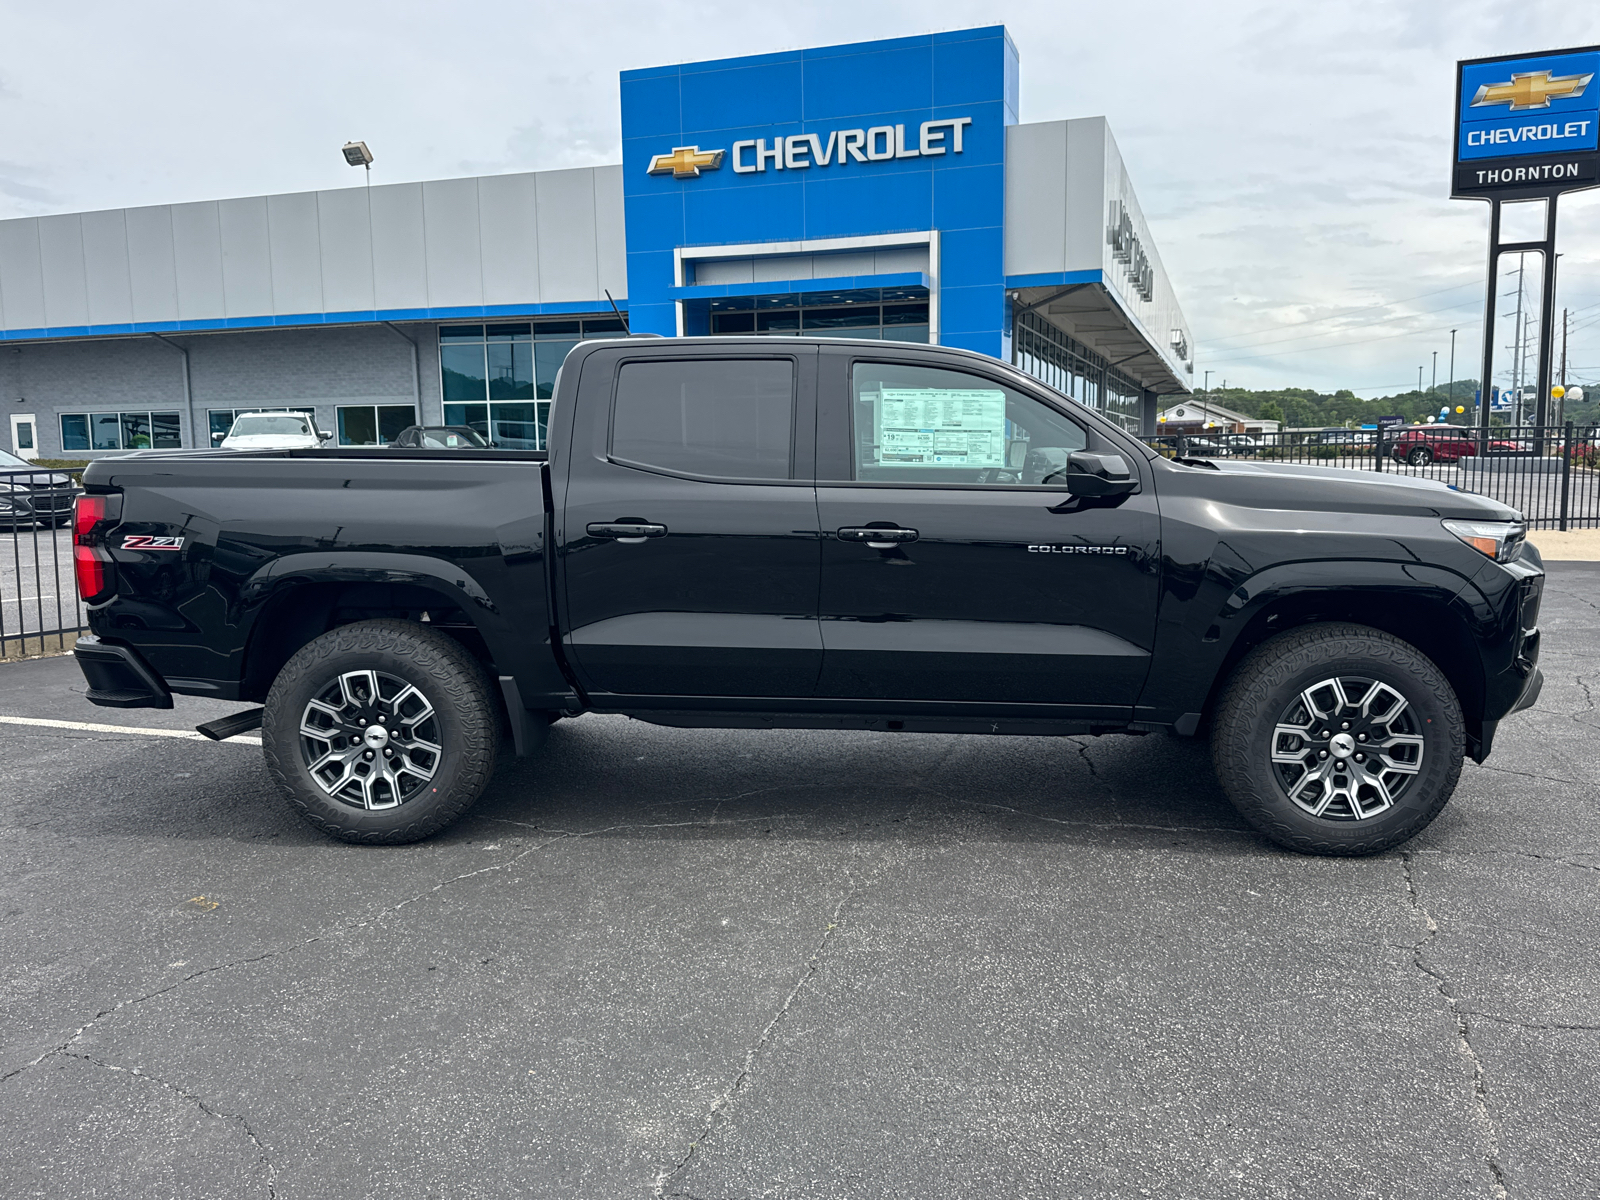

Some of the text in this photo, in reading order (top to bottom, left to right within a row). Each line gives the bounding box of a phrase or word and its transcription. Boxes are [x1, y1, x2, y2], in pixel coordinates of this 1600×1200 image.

[1467, 120, 1591, 146] CHEVROLET
[732, 116, 972, 173] CHEVROLET
[1476, 162, 1579, 184] THORNTON
[120, 535, 185, 550] Z71
[1027, 545, 1127, 554] COLORADO
